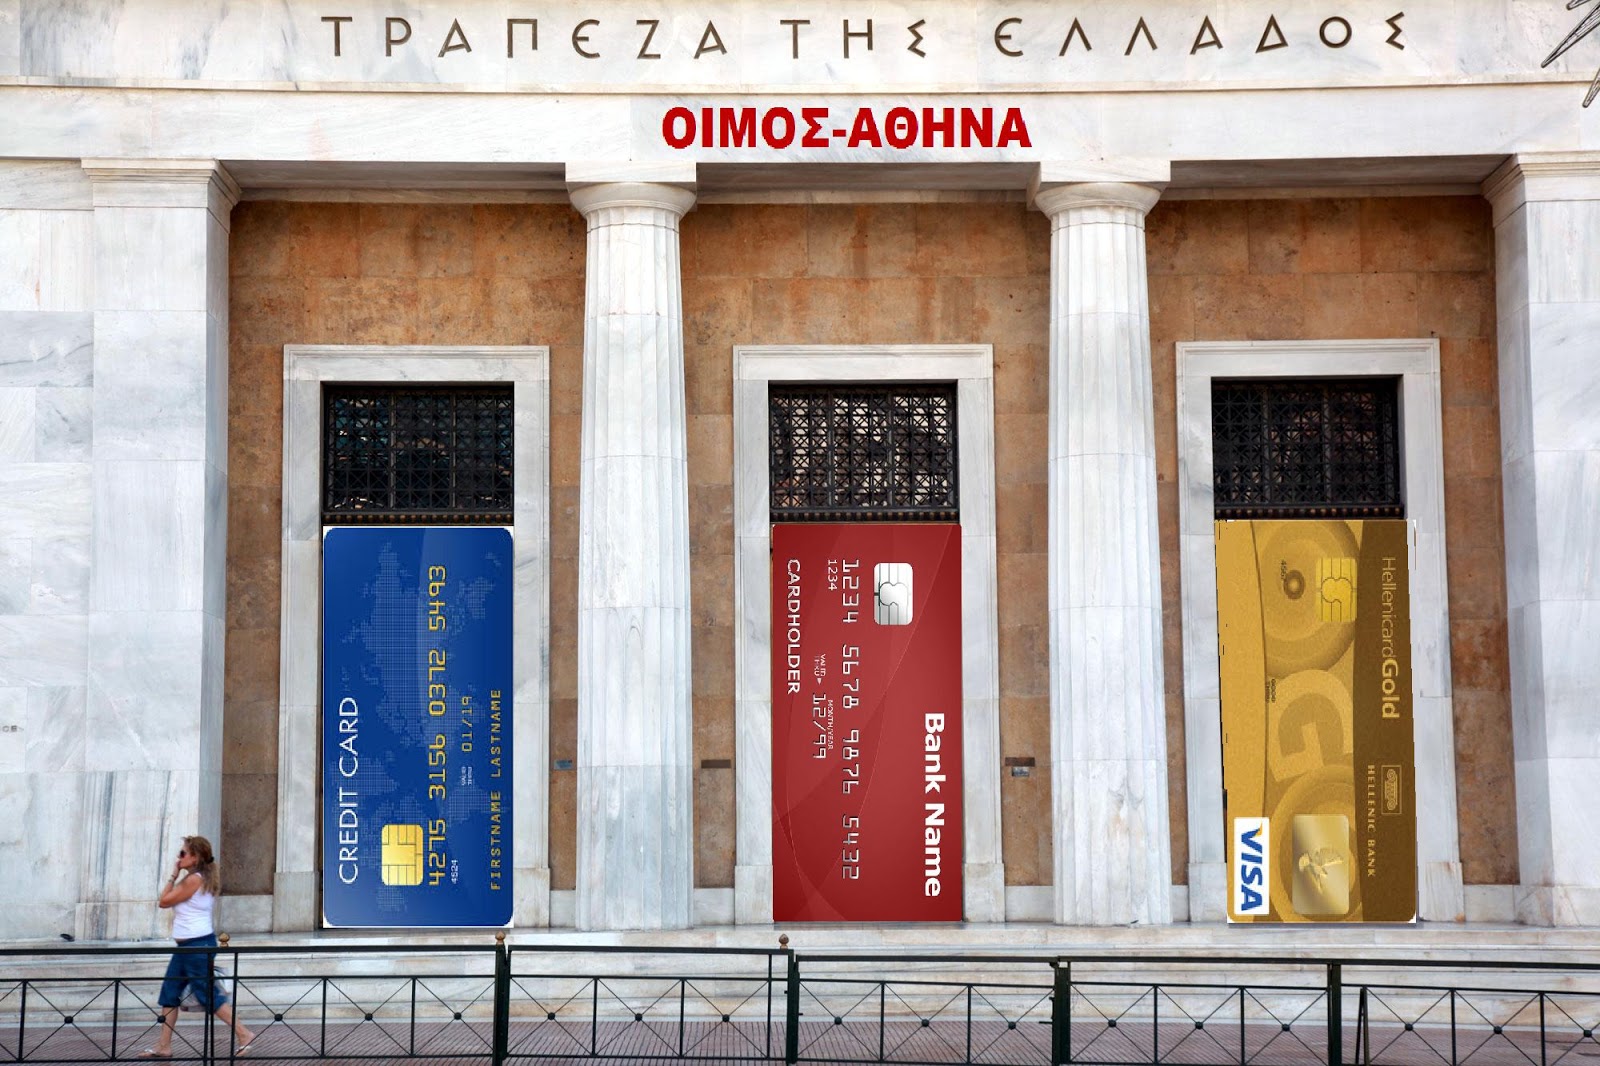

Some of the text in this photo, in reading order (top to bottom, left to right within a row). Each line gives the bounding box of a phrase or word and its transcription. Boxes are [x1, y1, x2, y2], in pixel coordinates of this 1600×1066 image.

[321, 11, 1406, 60] ΤΡΑΠΕΖΑ ΤΗΣ ΕΛΛΑΔΟΣ
[428, 565, 446, 631] 5493
[827, 559, 838, 591] 1234
[787, 559, 800, 695] CARDHOLDER
[428, 649, 446, 716] 0372
[842, 559, 860, 880] 1234 5678 9876 5432
[462, 696, 473, 752] 01/19
[813, 693, 826, 759] 12/99
[339, 697, 358, 884] CREDIT CARD
[490, 690, 501, 890] FIRSTNAME LASTNAME
[925, 713, 946, 896] Bank Name
[1367, 765, 1376, 877] HELLENIC BANK
[428, 818, 446, 886] 4275
[1241, 822, 1263, 911] VISA
